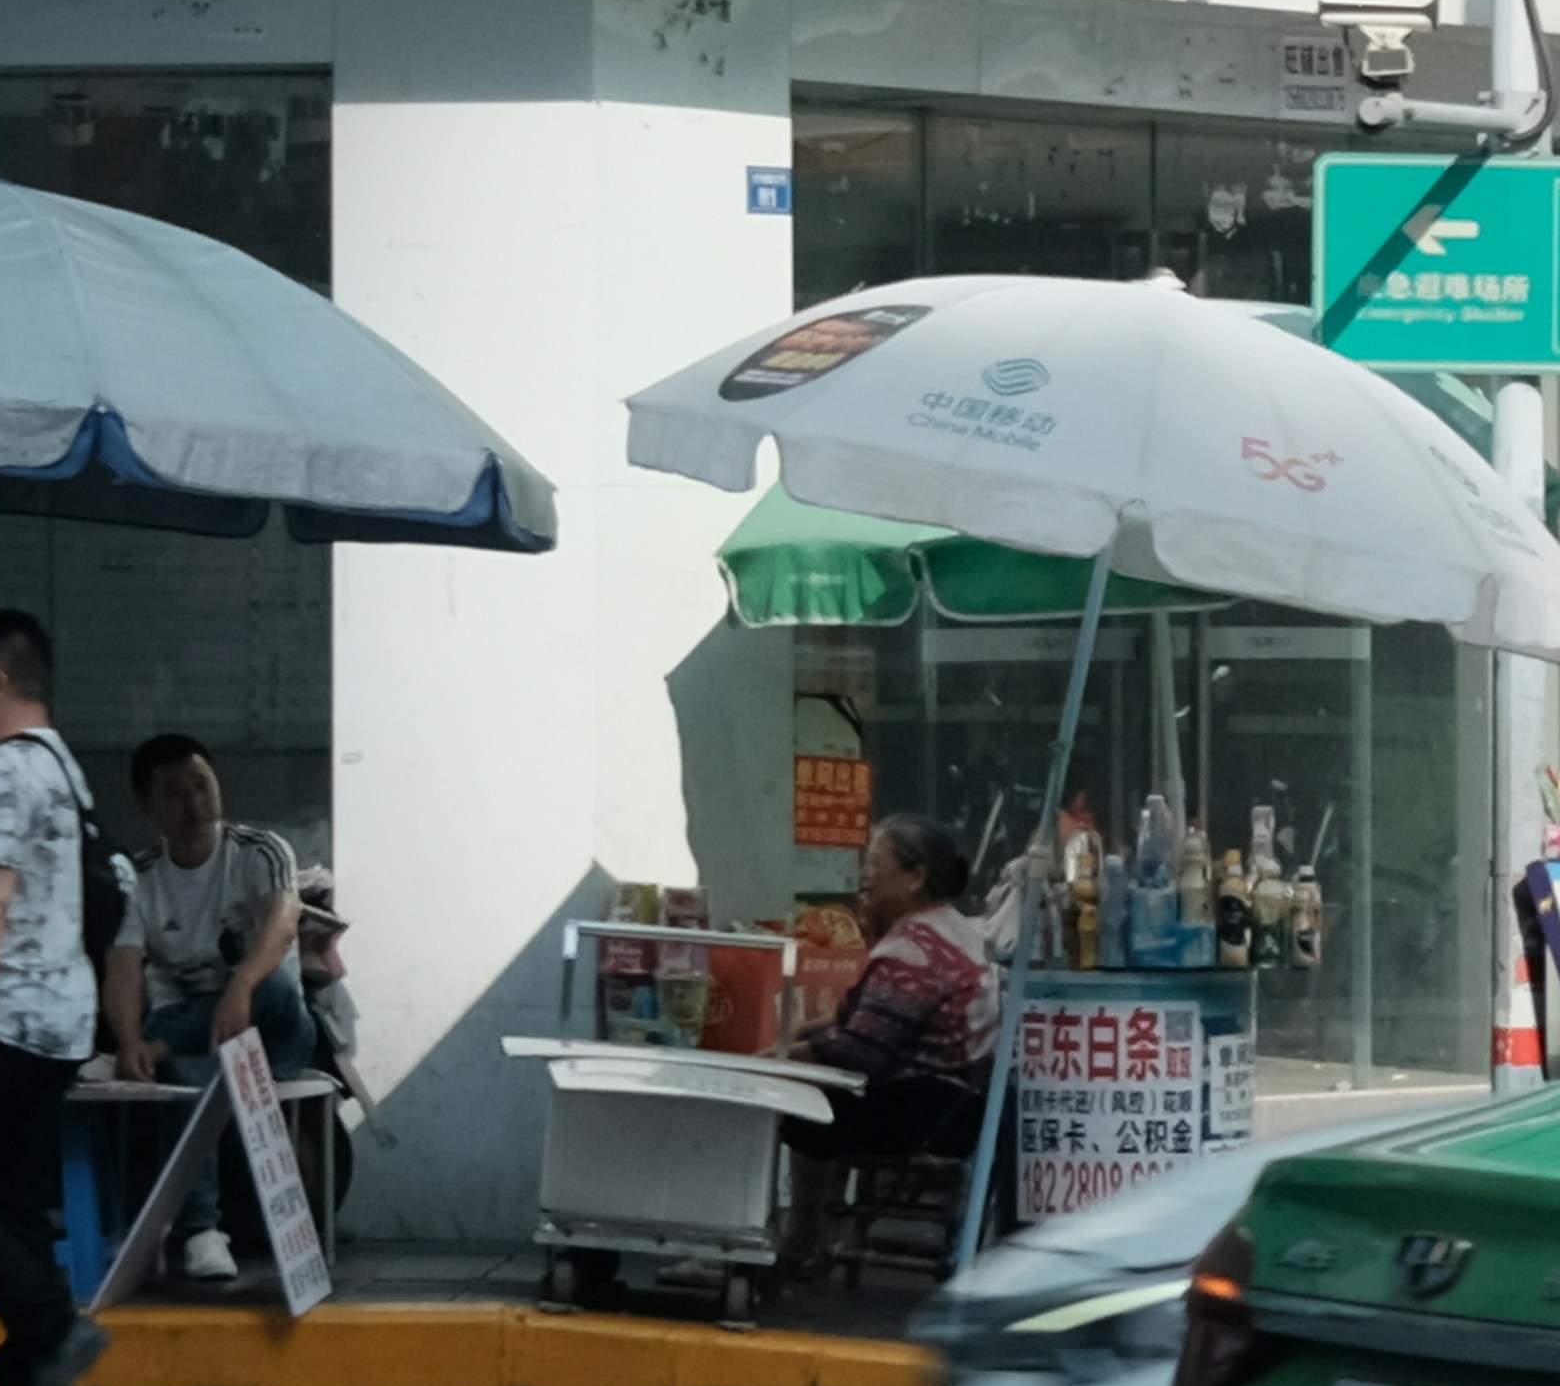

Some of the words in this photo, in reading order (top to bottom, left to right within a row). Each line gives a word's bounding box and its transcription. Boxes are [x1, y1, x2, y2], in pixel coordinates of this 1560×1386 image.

[1358, 270, 1529, 303] 应急避难场所
[907, 412, 967, 437] China
[973, 424, 1043, 451] Mobile
[922, 392, 1057, 435] 中国移动
[1022, 1005, 1160, 1082] 京东白条
[1022, 1116, 1193, 1154] 医保卡、公积金
